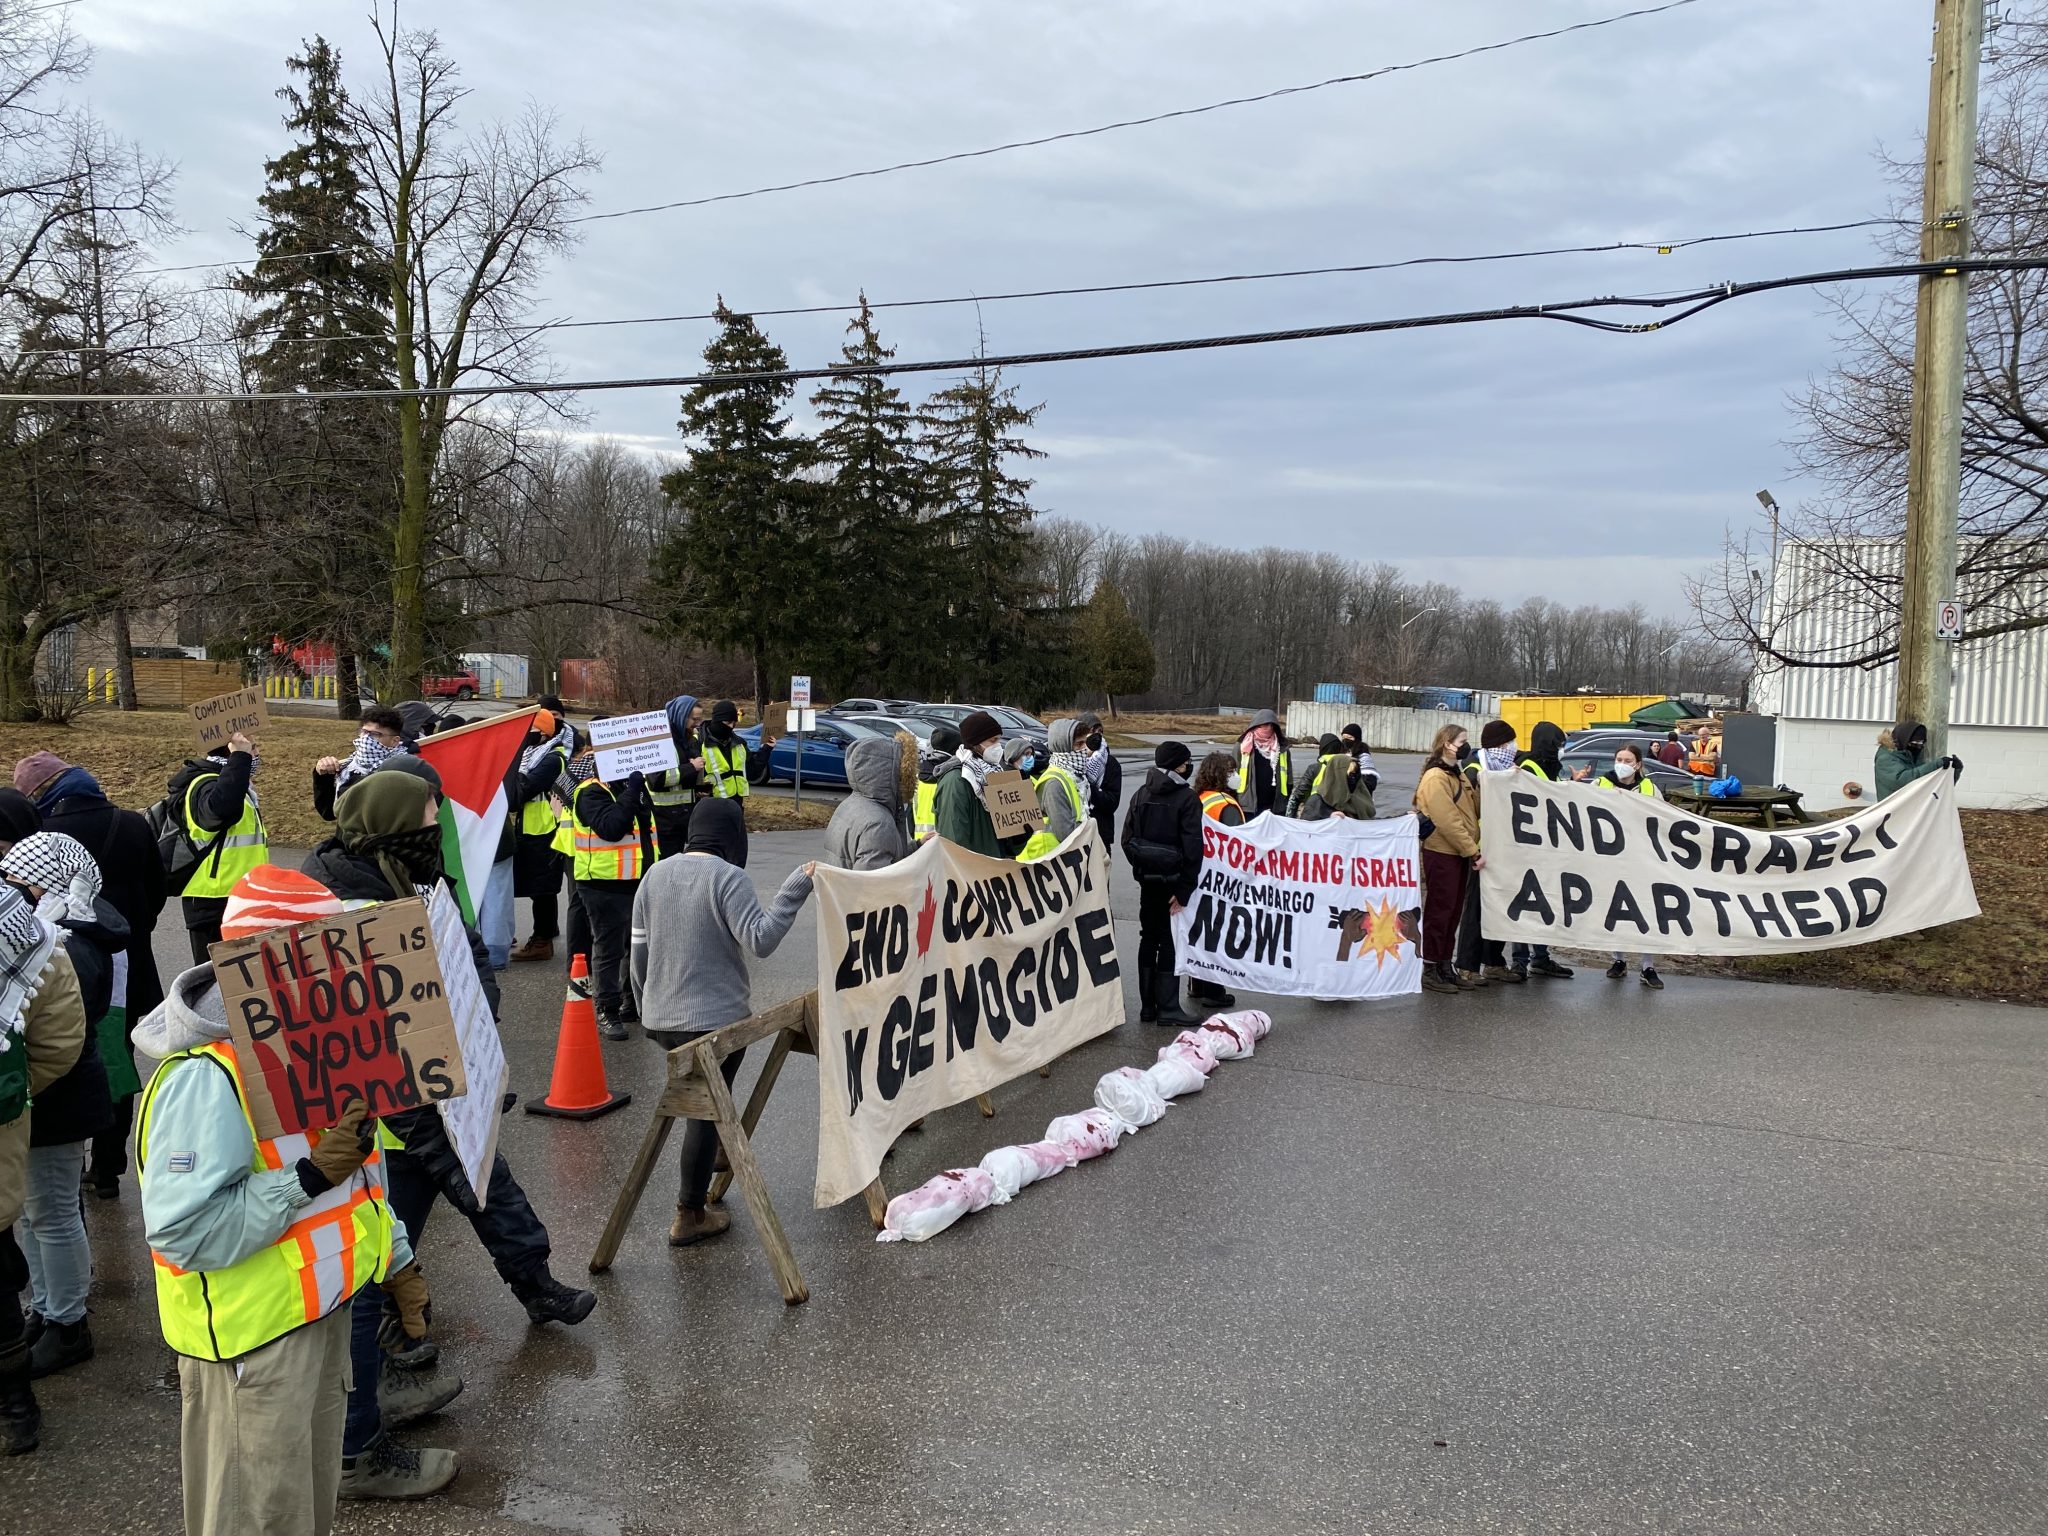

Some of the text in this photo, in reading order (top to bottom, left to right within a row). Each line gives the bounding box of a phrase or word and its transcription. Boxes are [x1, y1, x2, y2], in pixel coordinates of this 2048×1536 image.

[194, 692, 257, 720] COMPLICIT IN
[200, 712, 260, 742] WAR CRIMES
[589, 721, 610, 729] These
[611, 718, 627, 727] guns
[641, 713, 658, 721] used
[658, 711, 667, 719] by
[597, 730, 617, 739] Israel
[627, 727, 638, 735] kill
[640, 723, 668, 733] children
[616, 743, 660, 757] They literally
[617, 756, 633, 765] brag
[635, 753, 654, 761] about
[625, 763, 646, 772] social
[647, 759, 668, 768] media
[995, 808, 1043, 830] PALESTINE
[997, 789, 1021, 805] FREE
[1510, 791, 1898, 874] END ISRAELI
[1202, 825, 1417, 888] STOP ARMING ISRAEL
[1198, 868, 1315, 914] ARMS EMBARGO
[1507, 868, 1888, 938] APARTHEID
[218, 917, 386, 989] THERE
[835, 904, 910, 992] END
[1188, 894, 1294, 969] NOW!
[239, 964, 442, 1042] BLOOD on
[876, 907, 1121, 1101] GENOCIDE
[287, 1046, 454, 1130] Hands
